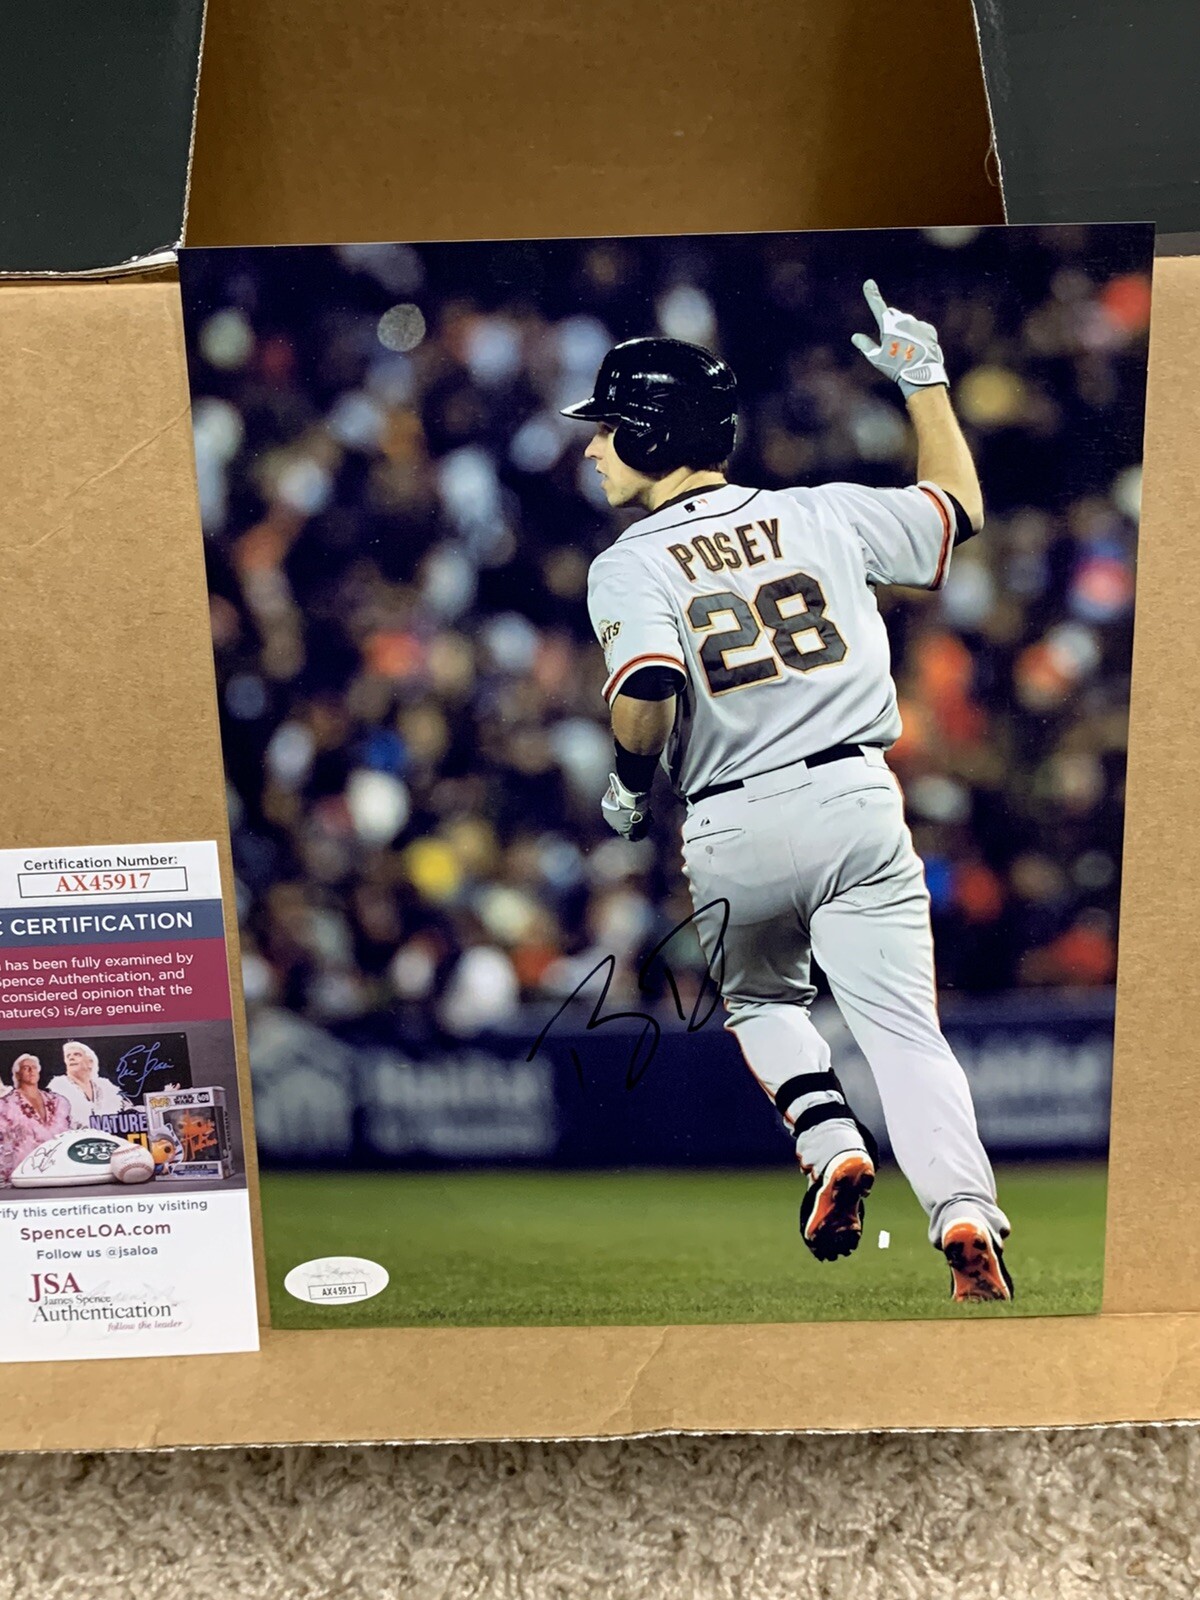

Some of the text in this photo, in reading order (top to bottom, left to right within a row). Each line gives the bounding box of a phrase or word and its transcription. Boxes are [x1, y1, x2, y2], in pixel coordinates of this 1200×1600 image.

[667, 518, 782, 583] POSEY
[685, 572, 848, 698] 28
[24, 855, 178, 871] Certification Number:
[55, 872, 151, 892] AX45917
[10, 911, 193, 935] CERTIFICATION
[5, 959, 29, 971] has
[33, 958, 67, 970] been
[71, 956, 101, 970] fully
[105, 953, 172, 966] examined
[176, 952, 194, 965] by
[49, 972, 155, 986] Authentication,
[159, 968, 185, 981] and
[2, 983, 193, 1003] considered opinion that the
[64, 1003, 102, 1017] is/are
[106, 1000, 165, 1015] genuine.
[90, 1114, 148, 1134] NATURE
[23, 1206, 48, 1218] this
[51, 1203, 134, 1217] certification
[138, 1202, 154, 1214] by
[159, 1199, 208, 1213] visiting
[20, 1223, 171, 1243] SpenceLOA.com
[36, 1245, 158, 1261] Follow us @jsaloa
[28, 1272, 84, 1303] JSA
[322, 1285, 357, 1296] AX45917
[43, 1294, 111, 1306] James Spence
[138, 1320, 152, 1330] the
[154, 1320, 183, 1329] leader
